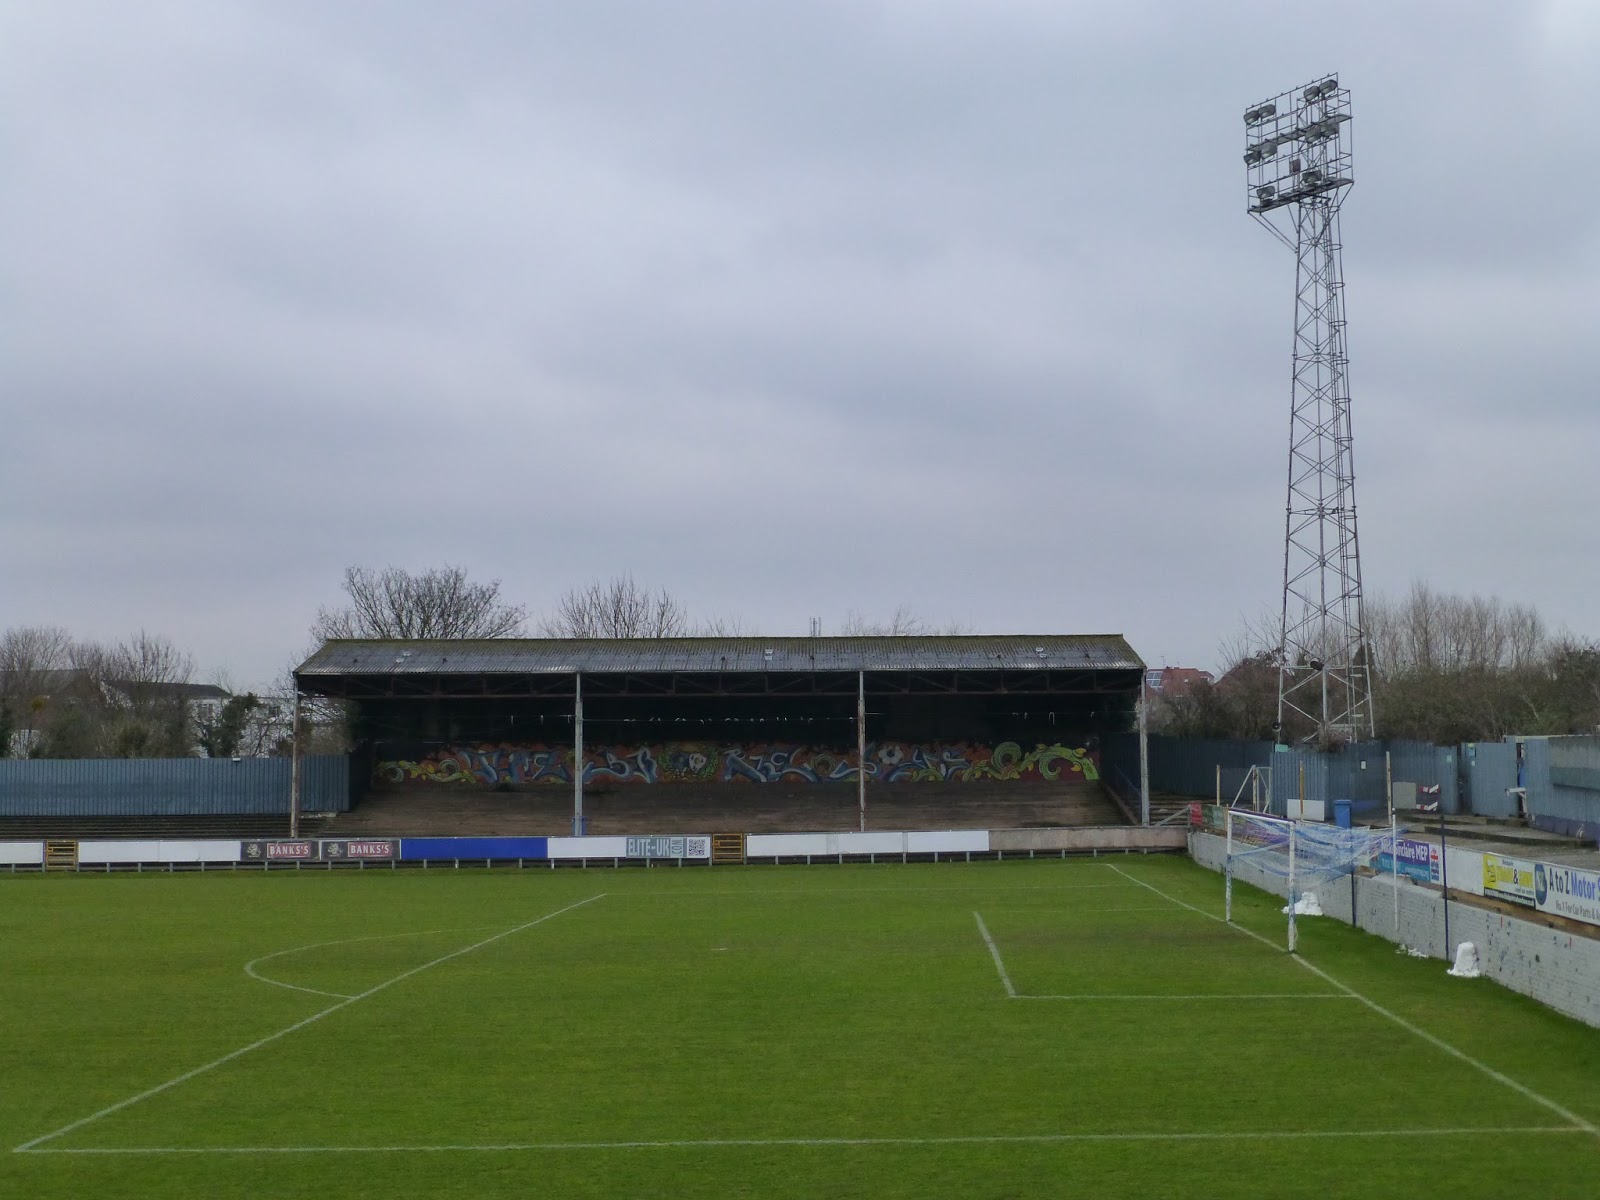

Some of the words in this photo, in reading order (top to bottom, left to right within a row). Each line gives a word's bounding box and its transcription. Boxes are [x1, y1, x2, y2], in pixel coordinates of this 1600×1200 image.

[269, 844, 309, 855] BANKS'S
[350, 844, 389, 855] BANKS'S
[628, 838, 669, 856] ELITE-UK
[1415, 844, 1428, 862] MEP
[1549, 867, 1554, 892] A
[1555, 870, 1564, 894] to
[1564, 870, 1570, 894] Z
[1571, 872, 1596, 900] Motor
